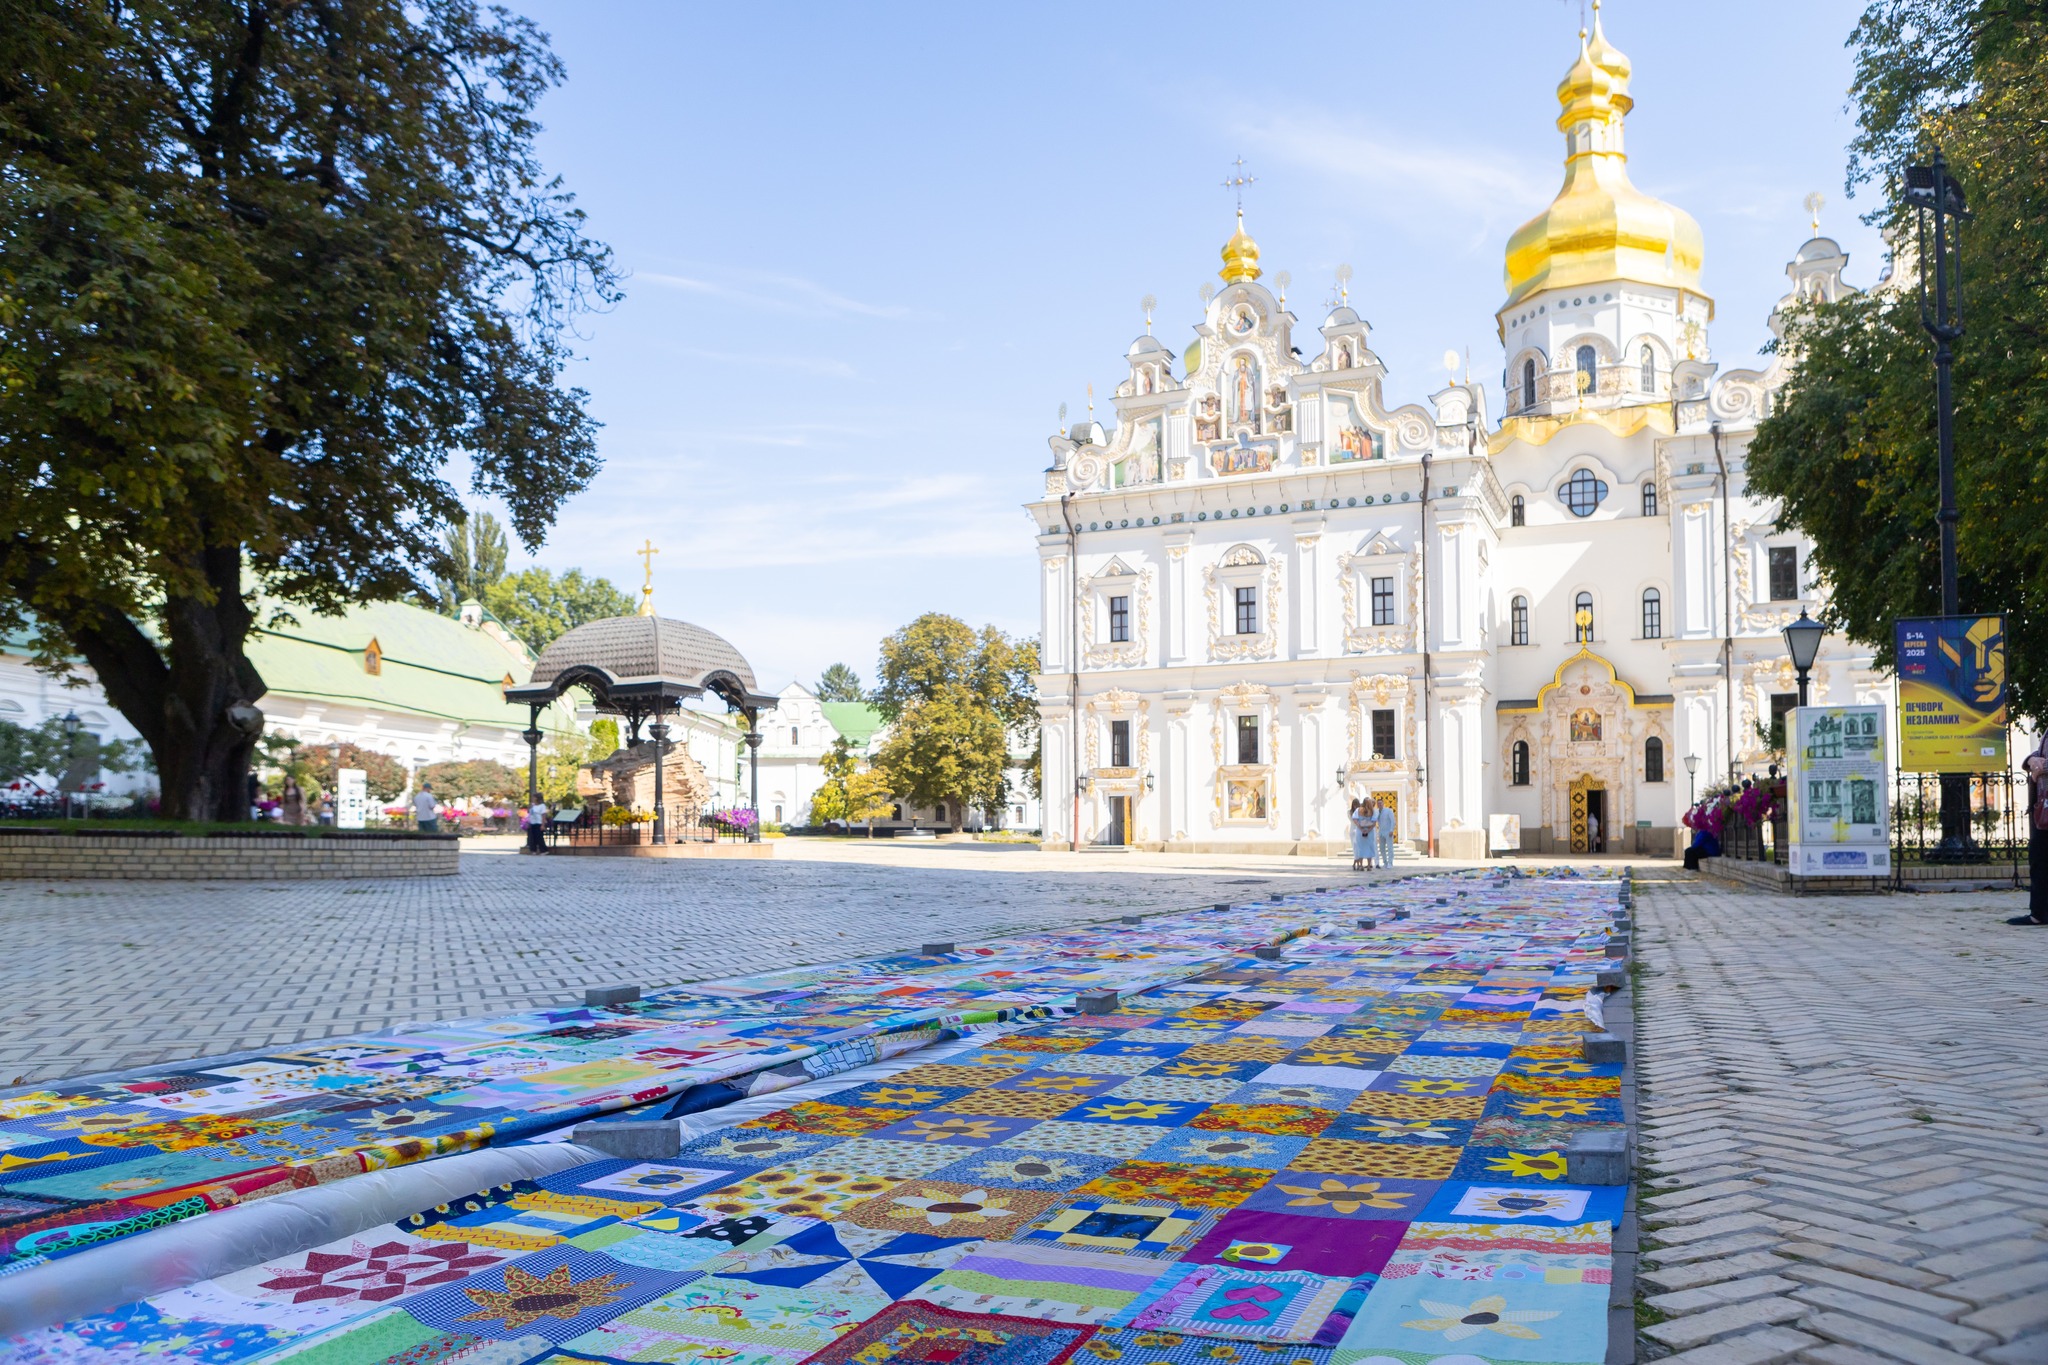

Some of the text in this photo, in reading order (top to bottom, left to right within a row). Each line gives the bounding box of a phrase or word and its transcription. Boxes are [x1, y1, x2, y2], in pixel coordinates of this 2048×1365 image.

[1906, 632, 1924, 640] 5-14
[1906, 649, 1926, 657] 2025
[1906, 702, 1943, 712] ПЕЧВОРК
[1906, 714, 1960, 725] НЕЗЛАМНИХ
